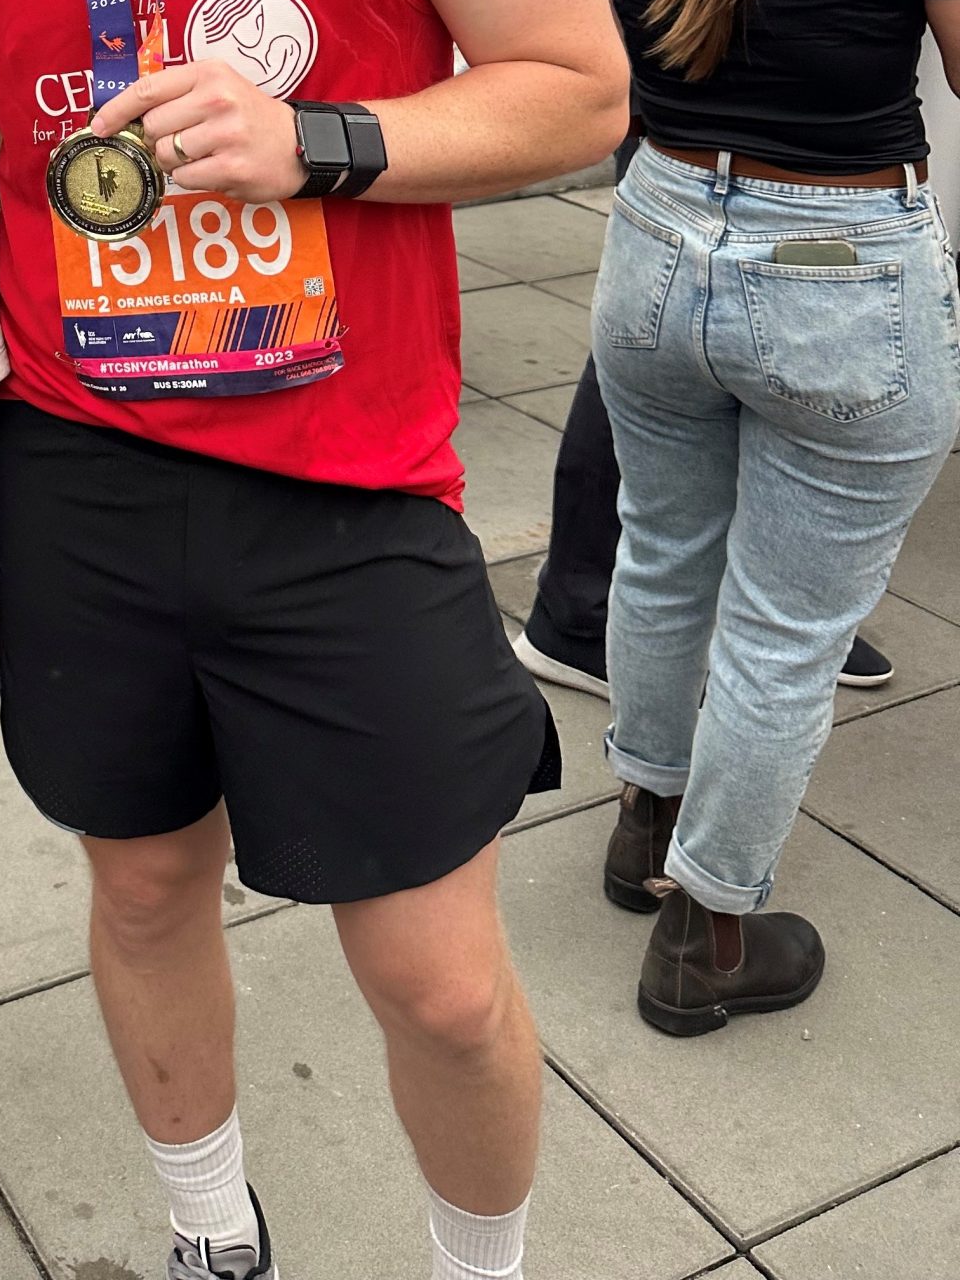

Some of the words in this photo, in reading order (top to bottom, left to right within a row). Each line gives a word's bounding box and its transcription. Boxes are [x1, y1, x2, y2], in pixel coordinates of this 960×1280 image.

[97, 80, 134, 90] 202
[33, 119, 55, 144] for
[65, 299, 95, 311] WAVE
[98, 296, 111, 313] 2
[117, 294, 171, 309] ORANGE
[173, 291, 225, 306] CORRAL
[228, 286, 246, 304] A
[254, 350, 294, 366] 2023
[100, 359, 218, 374] #TCSNYCMarathon
[153, 381, 171, 389] BUS
[172, 379, 207, 389] 5:30AM
